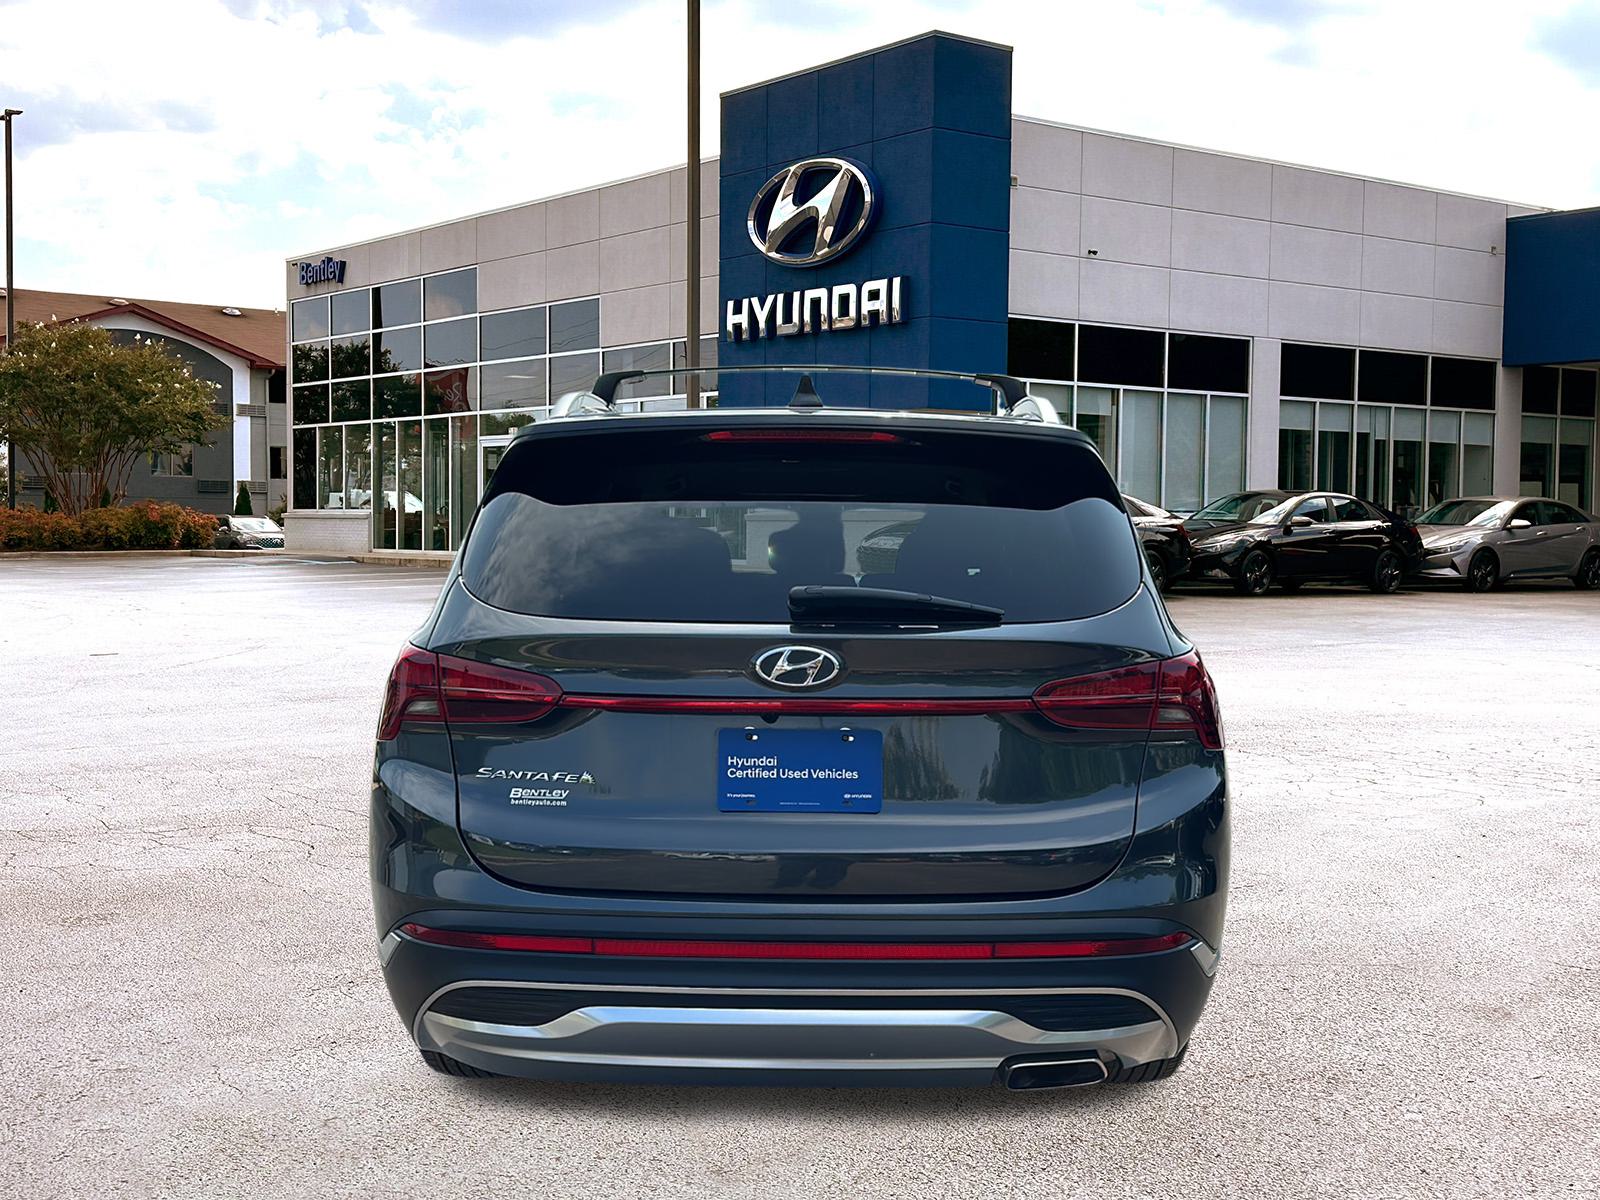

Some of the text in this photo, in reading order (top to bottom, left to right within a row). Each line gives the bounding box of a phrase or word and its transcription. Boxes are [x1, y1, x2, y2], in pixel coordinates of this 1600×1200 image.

[299, 257, 343, 285] Bentley
[726, 276, 902, 342] HYUNDAI
[727, 756, 777, 768] Hyundai
[475, 767, 580, 783] SANTA FE
[727, 768, 859, 779] Certified Used Vehicles
[510, 798, 567, 807] bentleyauto.com
